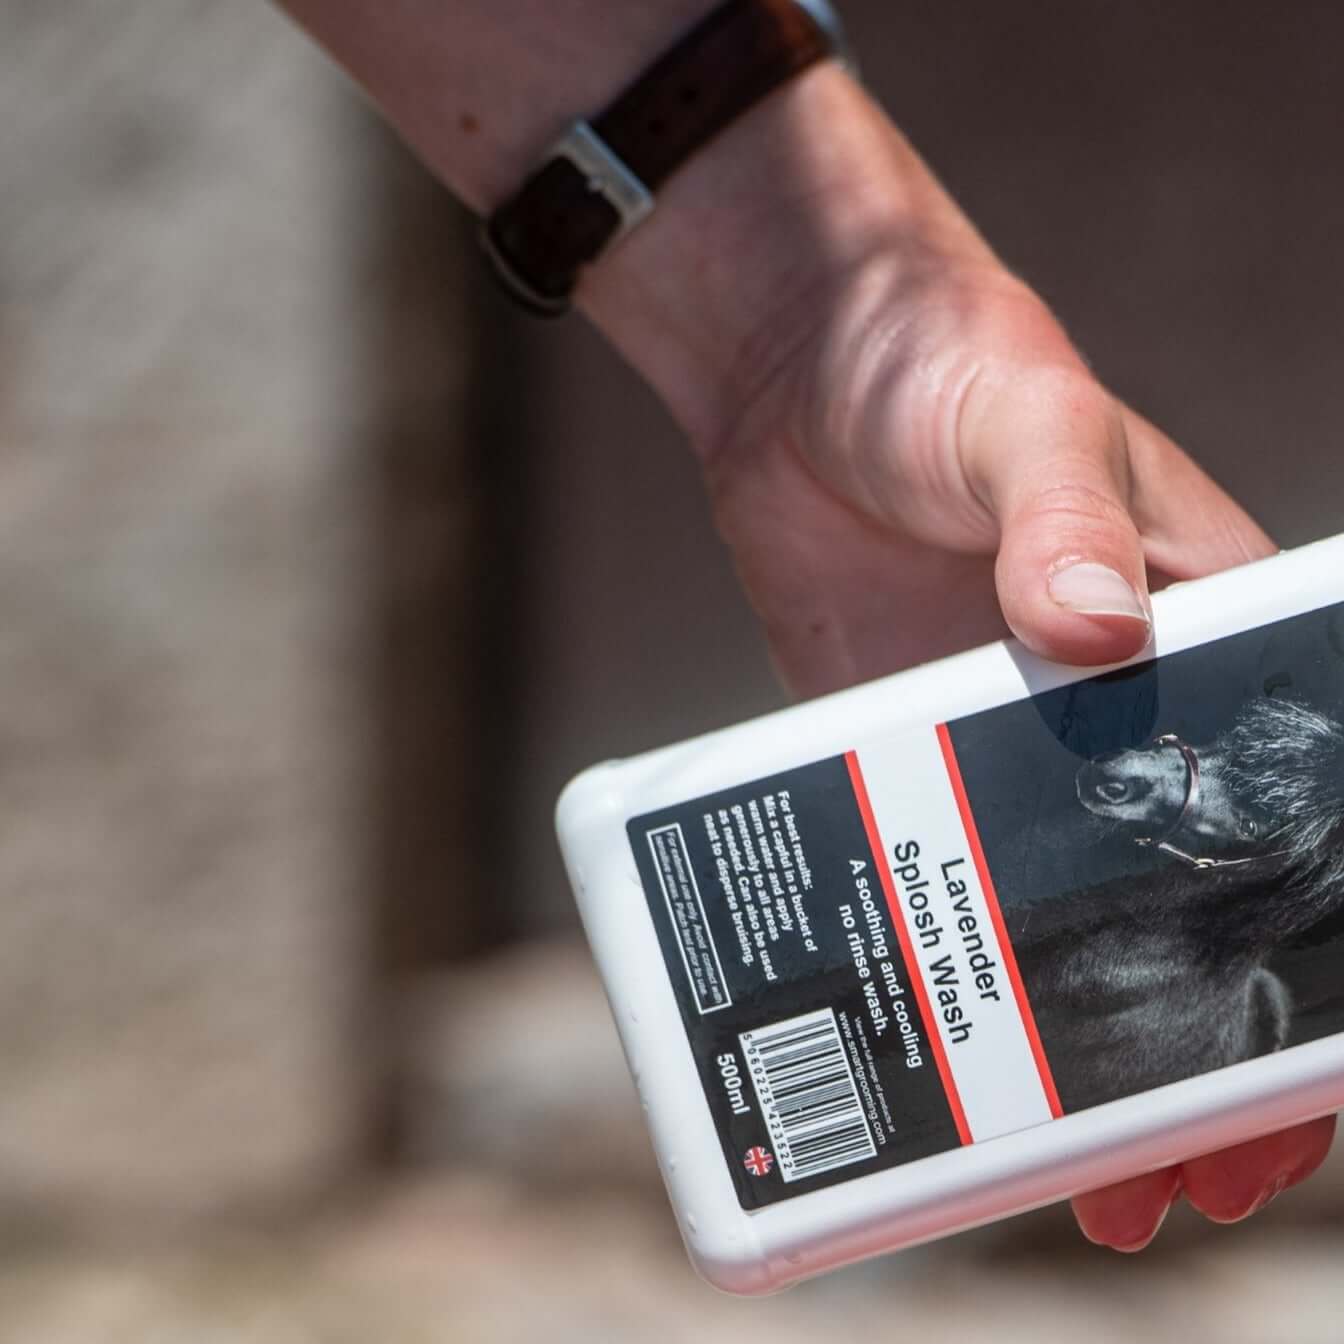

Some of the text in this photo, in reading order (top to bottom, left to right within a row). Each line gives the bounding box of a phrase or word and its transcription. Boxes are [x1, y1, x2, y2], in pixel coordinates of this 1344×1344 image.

[703, 813, 754, 967] neat to disperse bruising.
[718, 809, 778, 981] as needed. Can also be used
[730, 804, 780, 941] generously to all areas
[748, 799, 794, 931] warm water and apply
[762, 794, 818, 952] Mix a capful in a bucket of
[777, 790, 813, 891] For best results:
[838, 904, 889, 1036] no rinse wash.
[849, 859, 923, 1069] A soothing and cooling
[893, 839, 973, 1044] Splosh Wash
[940, 857, 1001, 1002] Lavender
[717, 1053, 751, 1115] 500ml
[743, 1033, 793, 1170] 5 060225 423522
[838, 1011, 887, 1145] www.smartgrooming.com
